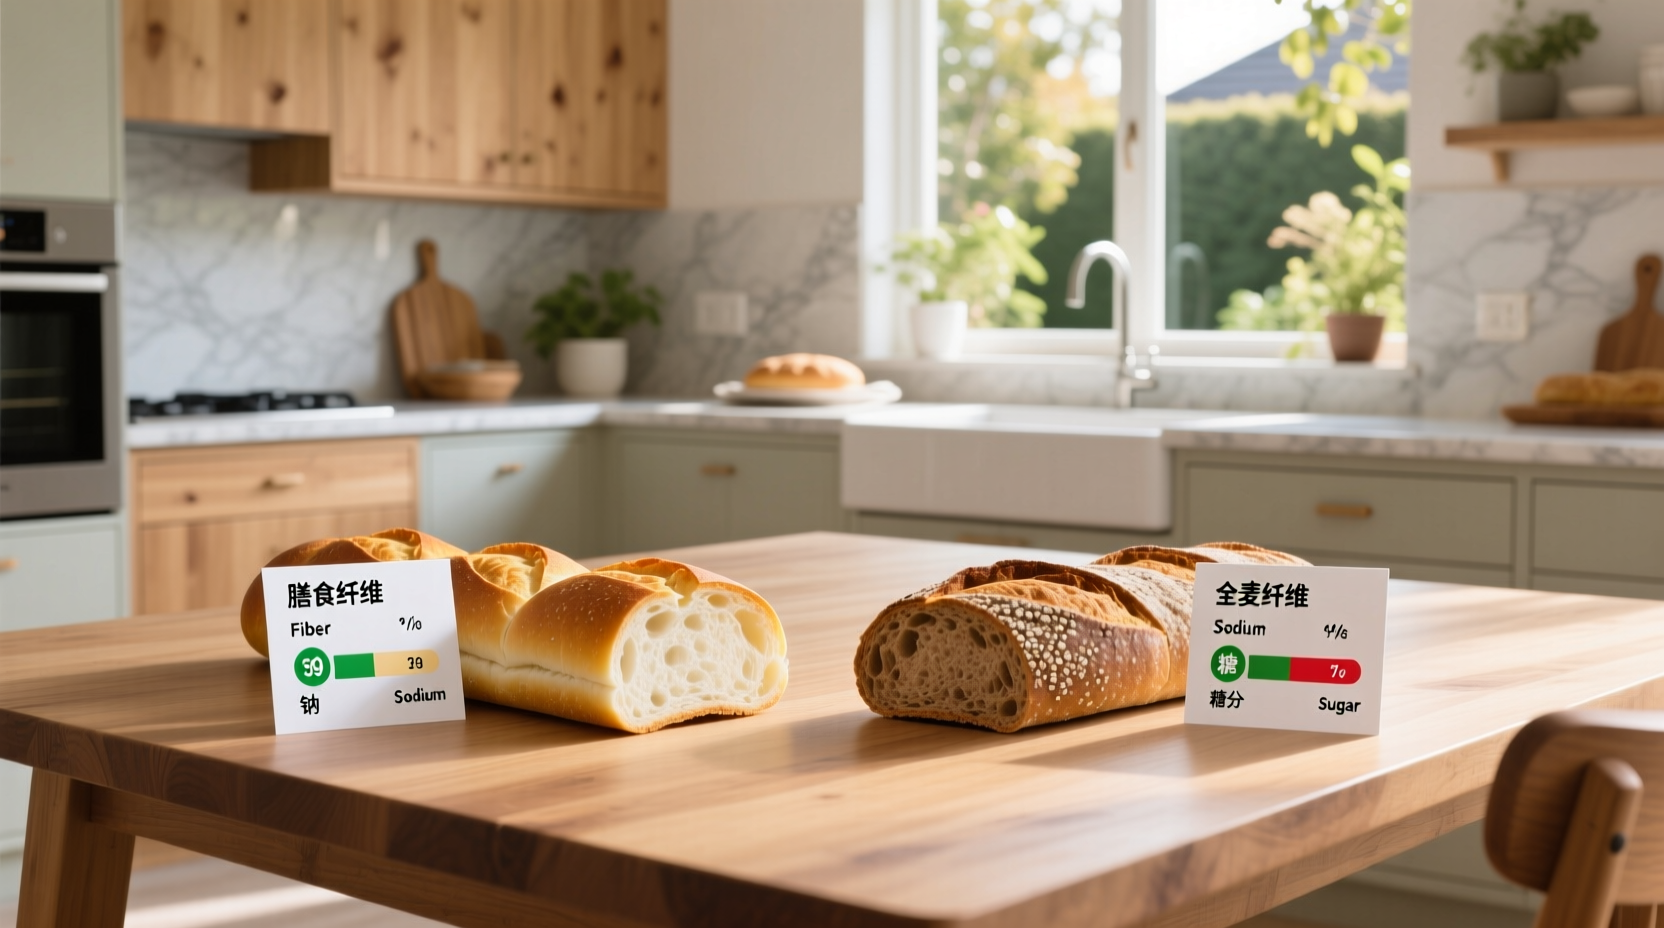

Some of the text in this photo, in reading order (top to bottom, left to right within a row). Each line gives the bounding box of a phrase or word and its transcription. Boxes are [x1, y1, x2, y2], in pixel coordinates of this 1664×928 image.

[287, 579, 384, 609] 膳食纤维
[1215, 580, 1310, 608] 全麦纤维
[290, 621, 331, 638] Fiber
[394, 688, 446, 704] Sodium
[1318, 697, 1361, 715] Sugar
